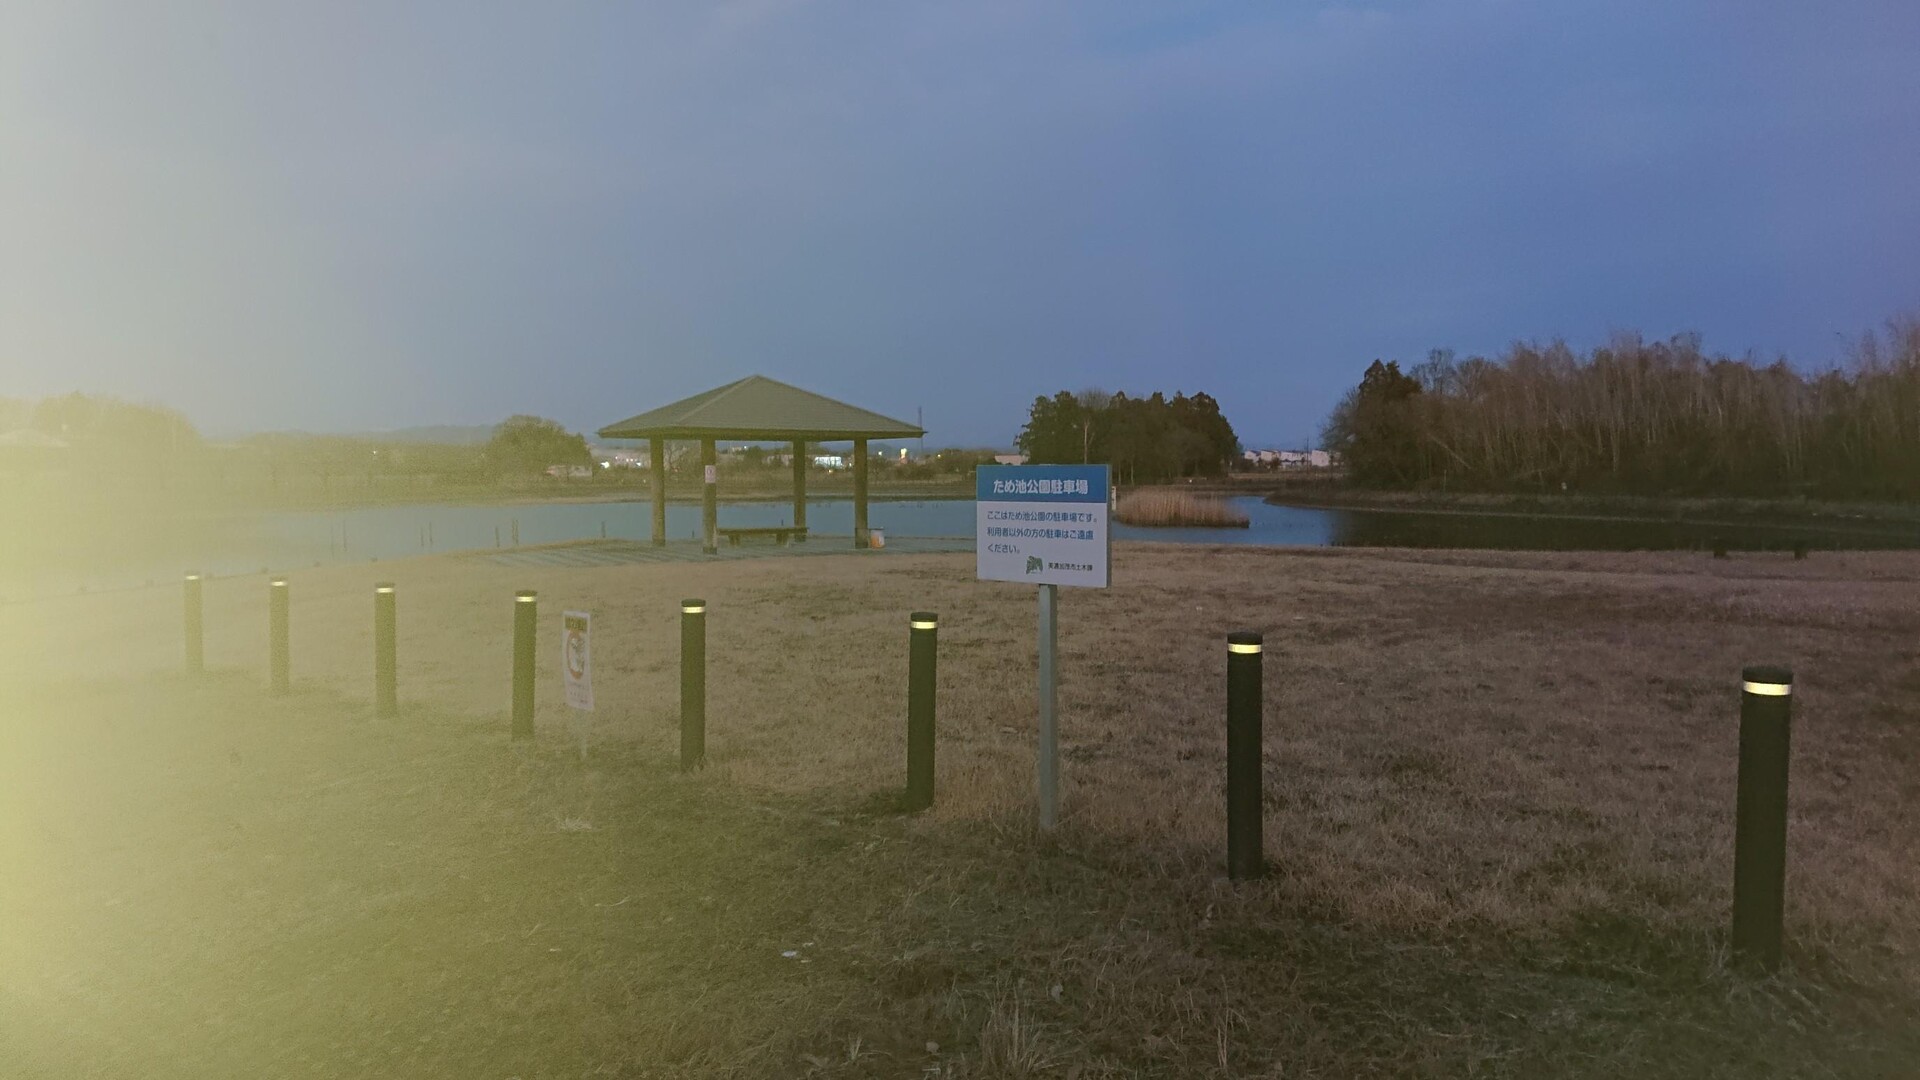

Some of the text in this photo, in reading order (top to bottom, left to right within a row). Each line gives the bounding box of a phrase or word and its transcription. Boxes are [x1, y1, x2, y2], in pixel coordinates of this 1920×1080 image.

[993, 479, 1089, 495] ため池公園駐車場
[987, 511, 1098, 523] ここはため池公園の駐車場です。
[986, 527, 1094, 540] 利用者以外の方の駐車はご遠慮
[987, 543, 1020, 554] ください。
